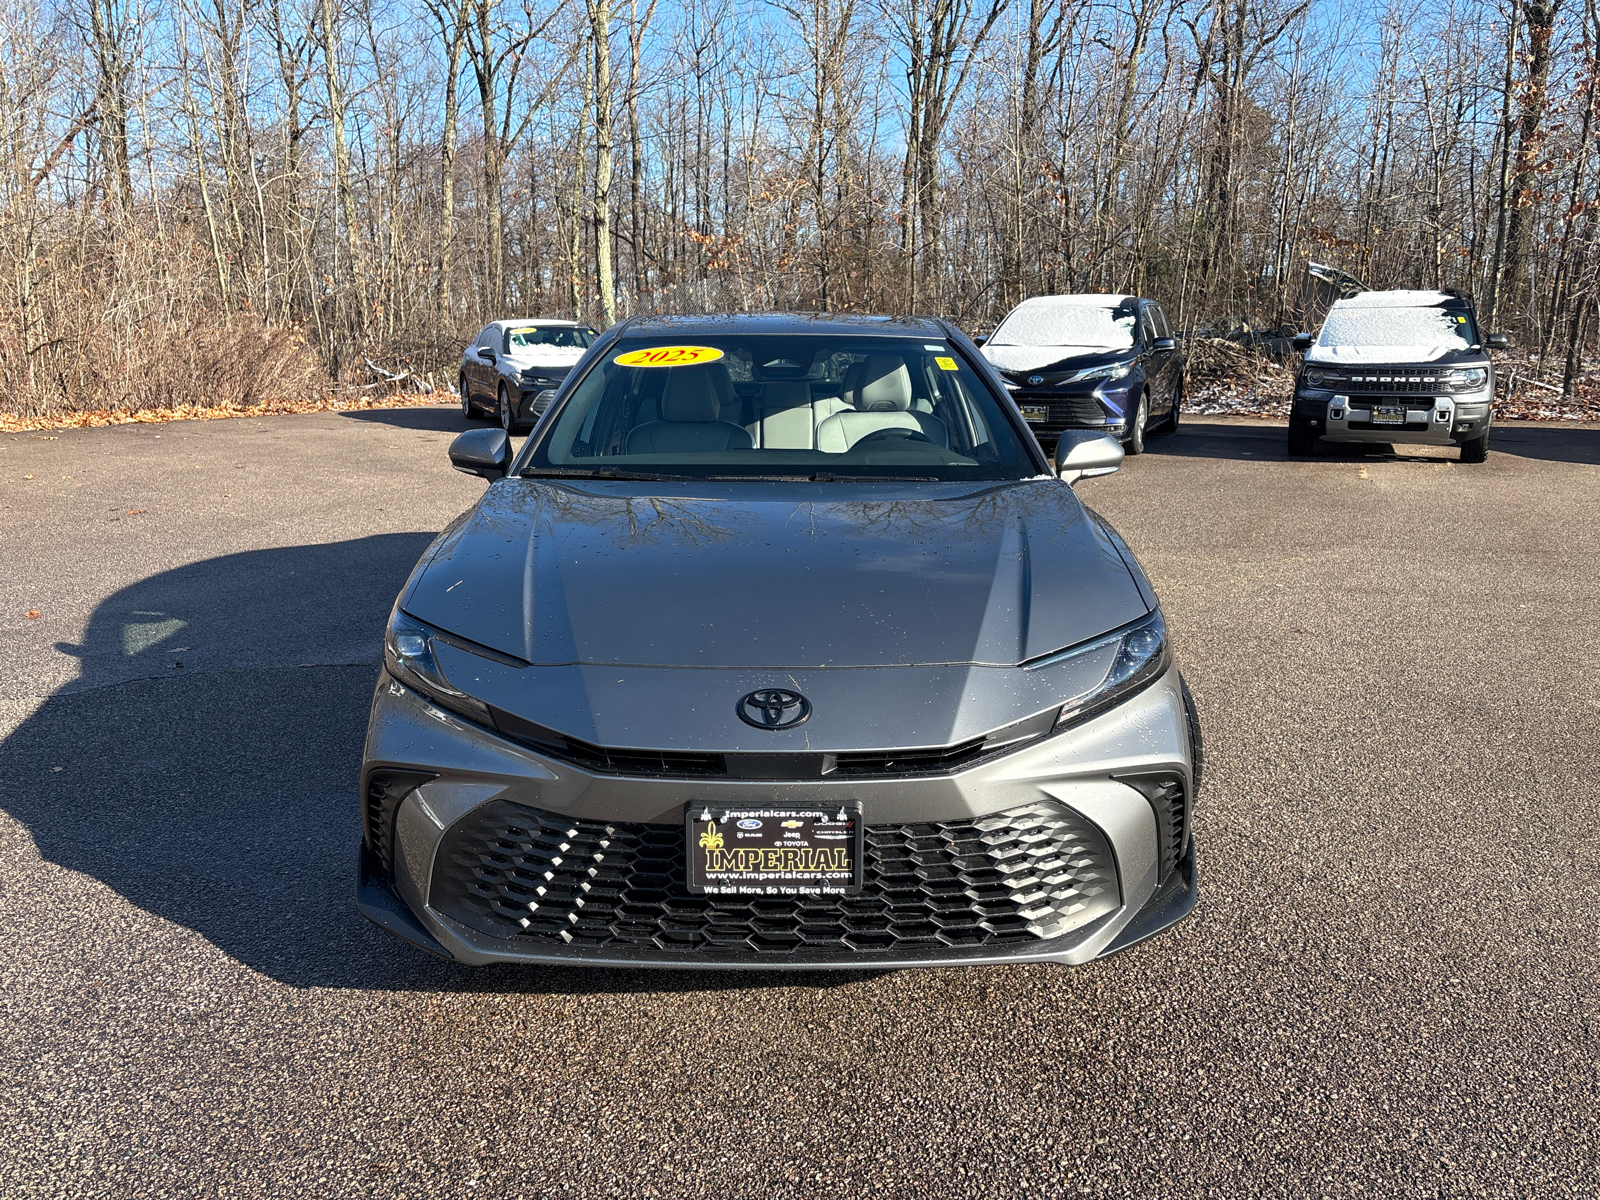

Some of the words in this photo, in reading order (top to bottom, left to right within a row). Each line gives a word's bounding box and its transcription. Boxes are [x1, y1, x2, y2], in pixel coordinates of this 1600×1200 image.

[629, 349, 705, 364] 2025
[725, 810, 823, 819] Imperialcars.com
[783, 831, 801, 839] Jeep
[705, 848, 853, 871] IMPERIAL
[705, 871, 853, 880] www.imperialcars.com
[703, 886, 719, 894] We
[720, 886, 737, 894] Sell
[739, 886, 764, 895] More,
[766, 886, 778, 894] So
[780, 886, 797, 894] You
[799, 886, 821, 894] Save
[823, 886, 846, 894] More
